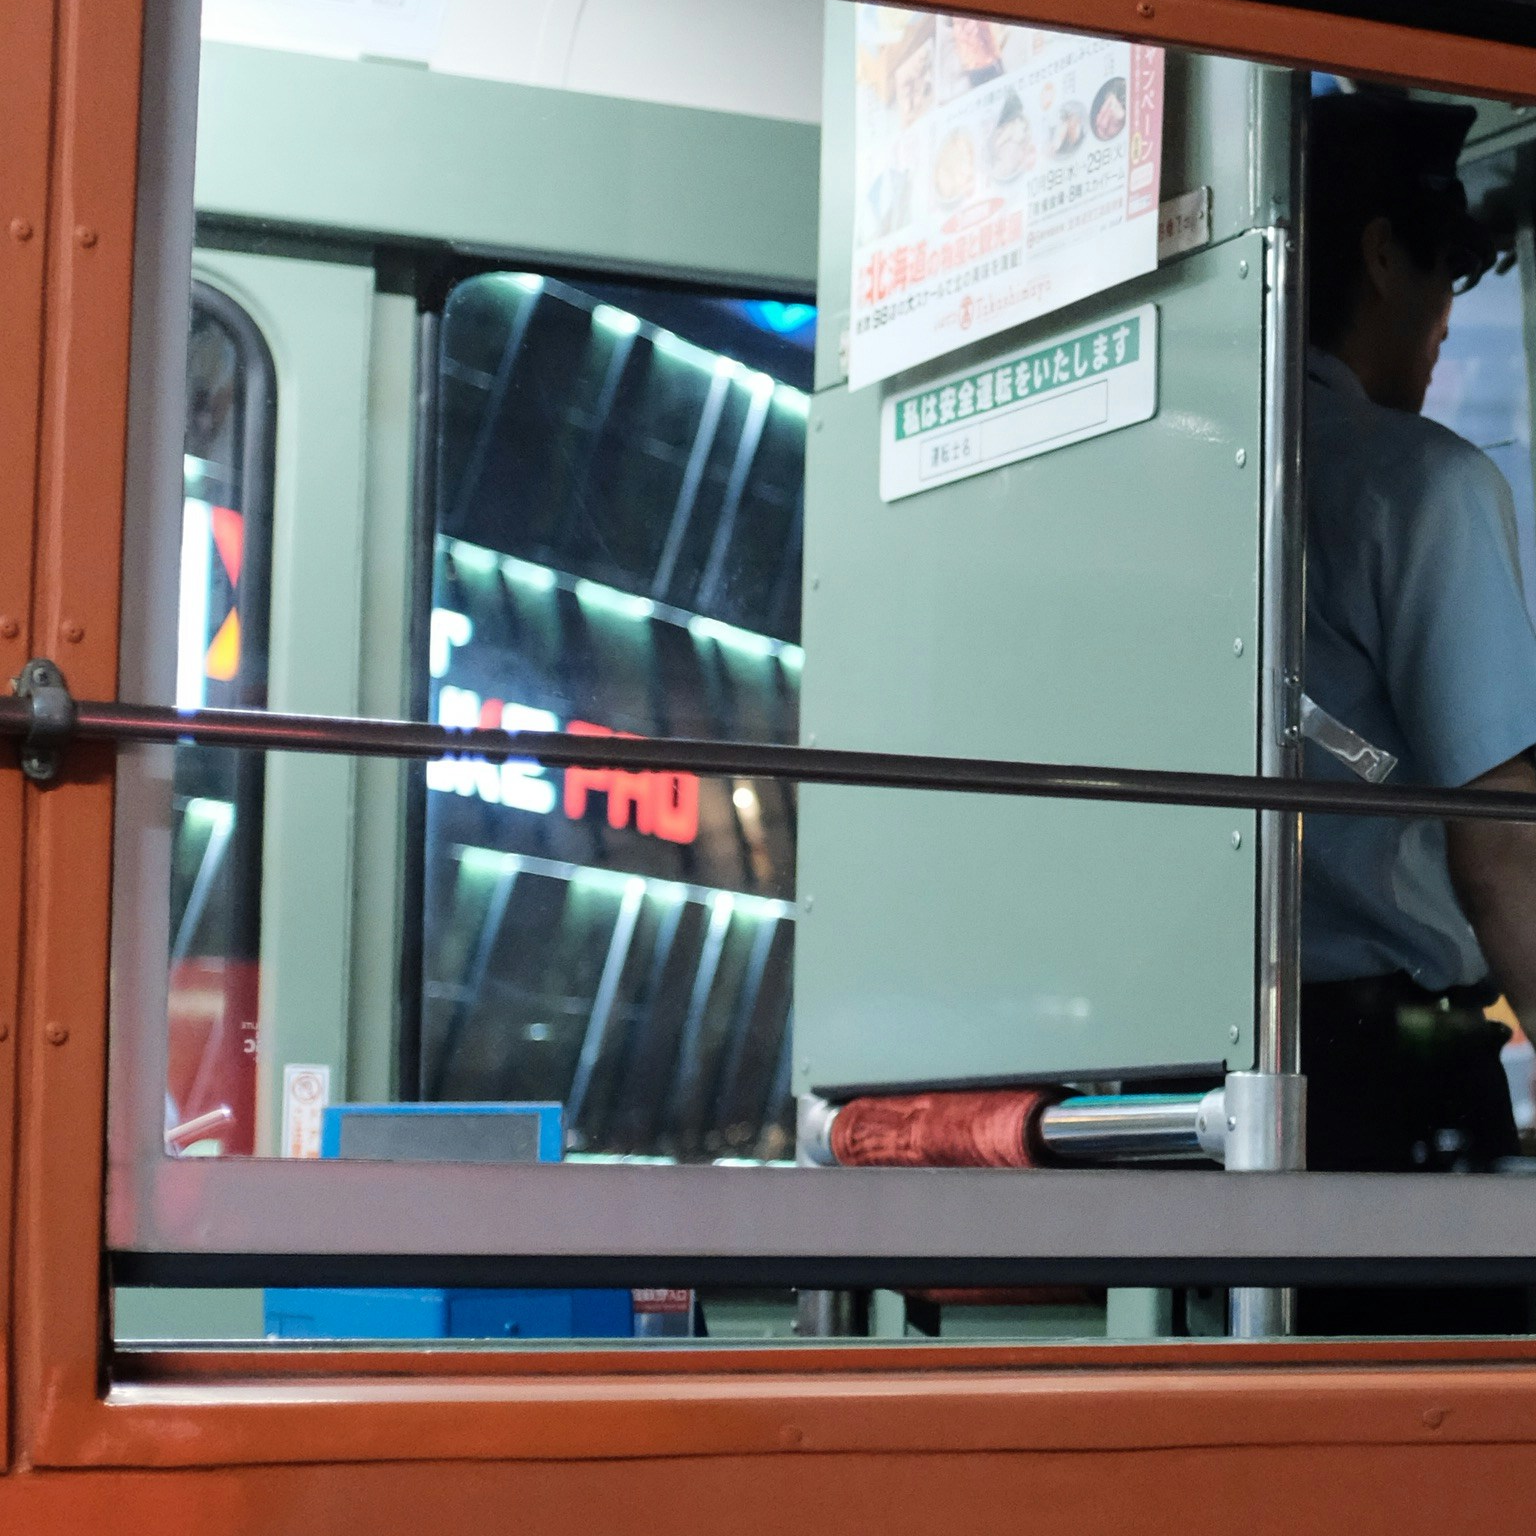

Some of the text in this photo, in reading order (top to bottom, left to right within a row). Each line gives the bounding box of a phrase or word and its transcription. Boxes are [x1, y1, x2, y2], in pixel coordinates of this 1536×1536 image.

[903, 325, 1131, 435] 私は安全運転をいたします
